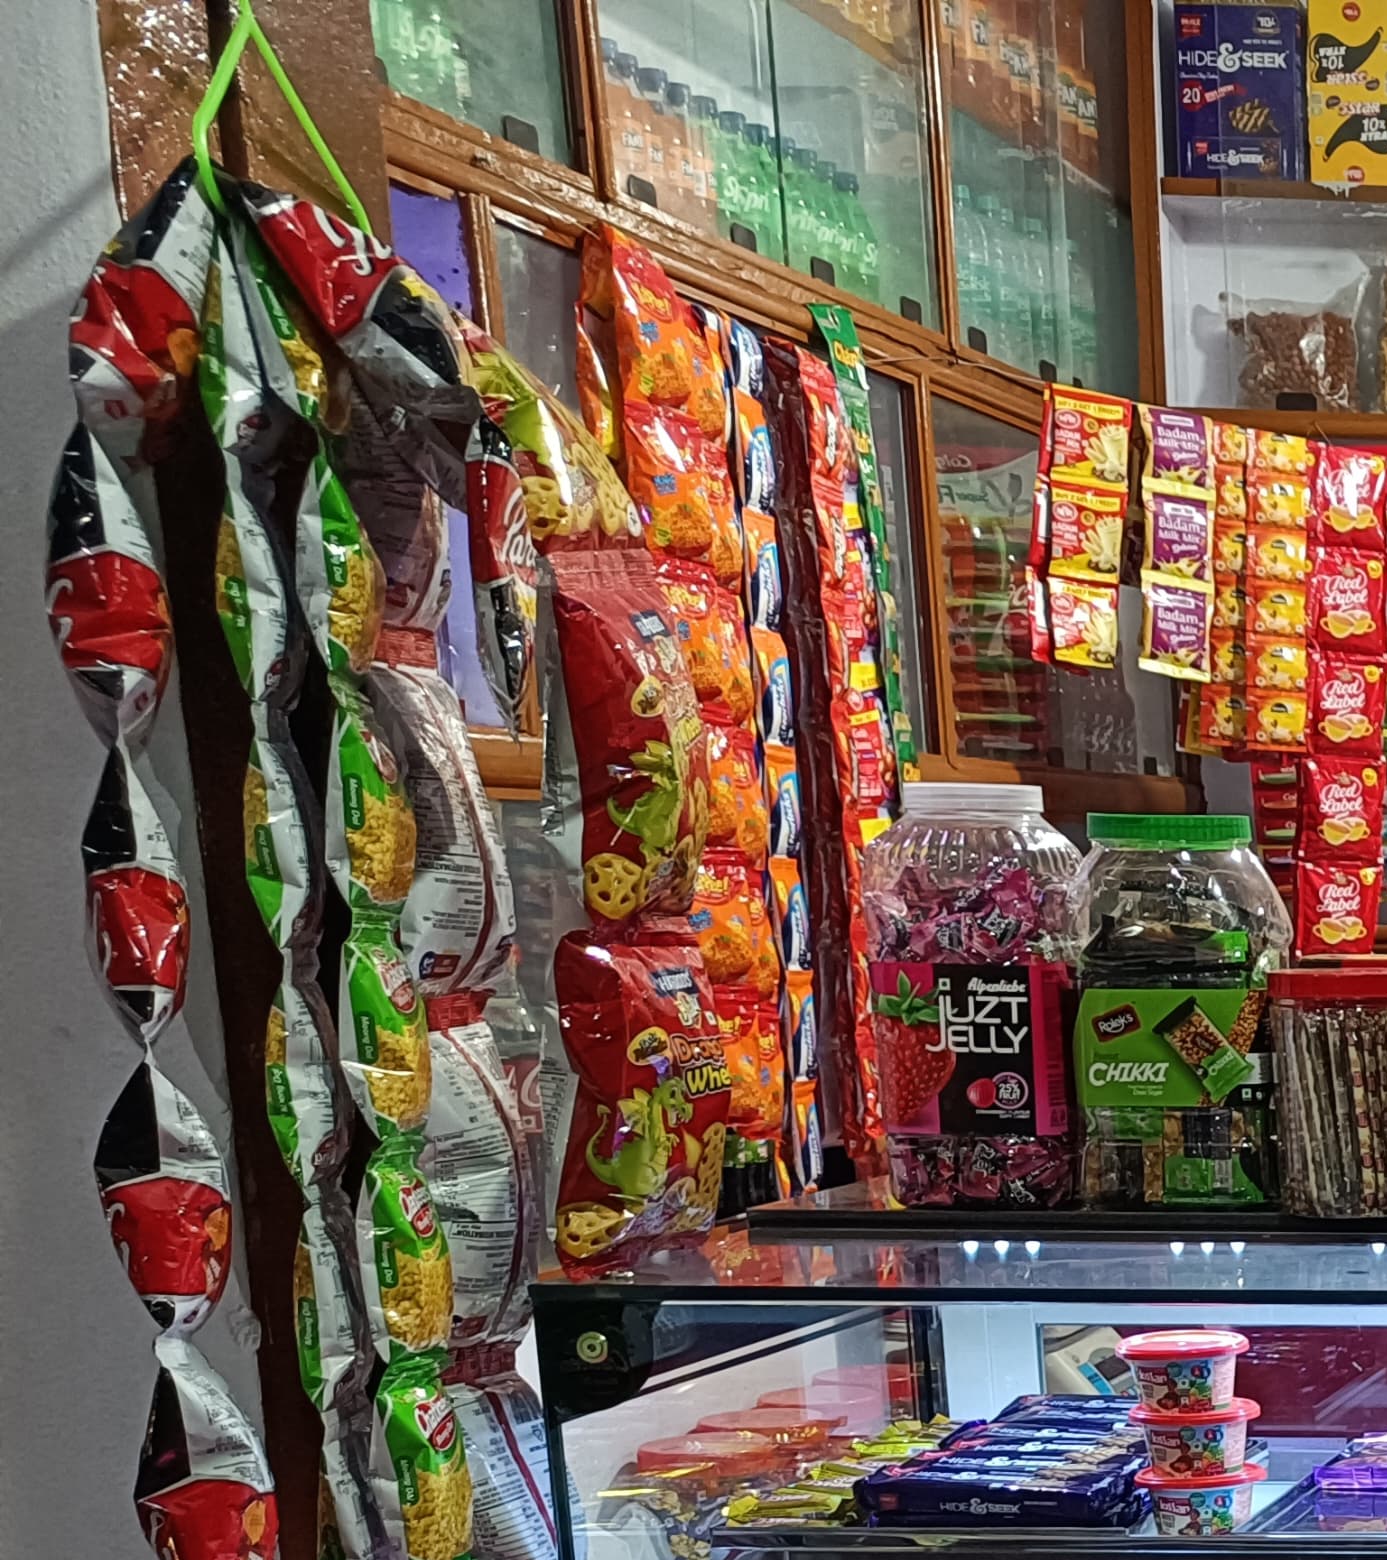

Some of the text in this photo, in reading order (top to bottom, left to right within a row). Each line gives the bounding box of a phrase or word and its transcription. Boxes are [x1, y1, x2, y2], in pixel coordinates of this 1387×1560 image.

[1157, 426, 1200, 441] Badam
[1158, 516, 1201, 532] Badam
[1157, 607, 1200, 624] Badam
[1322, 676, 1364, 700] Red
[1321, 691, 1366, 710] Label
[1321, 782, 1362, 806] Red
[1320, 796, 1364, 814] Label
[1320, 881, 1360, 905] Red
[1318, 895, 1361, 914] Label
[1088, 1062, 1170, 1087] CHIKKI
